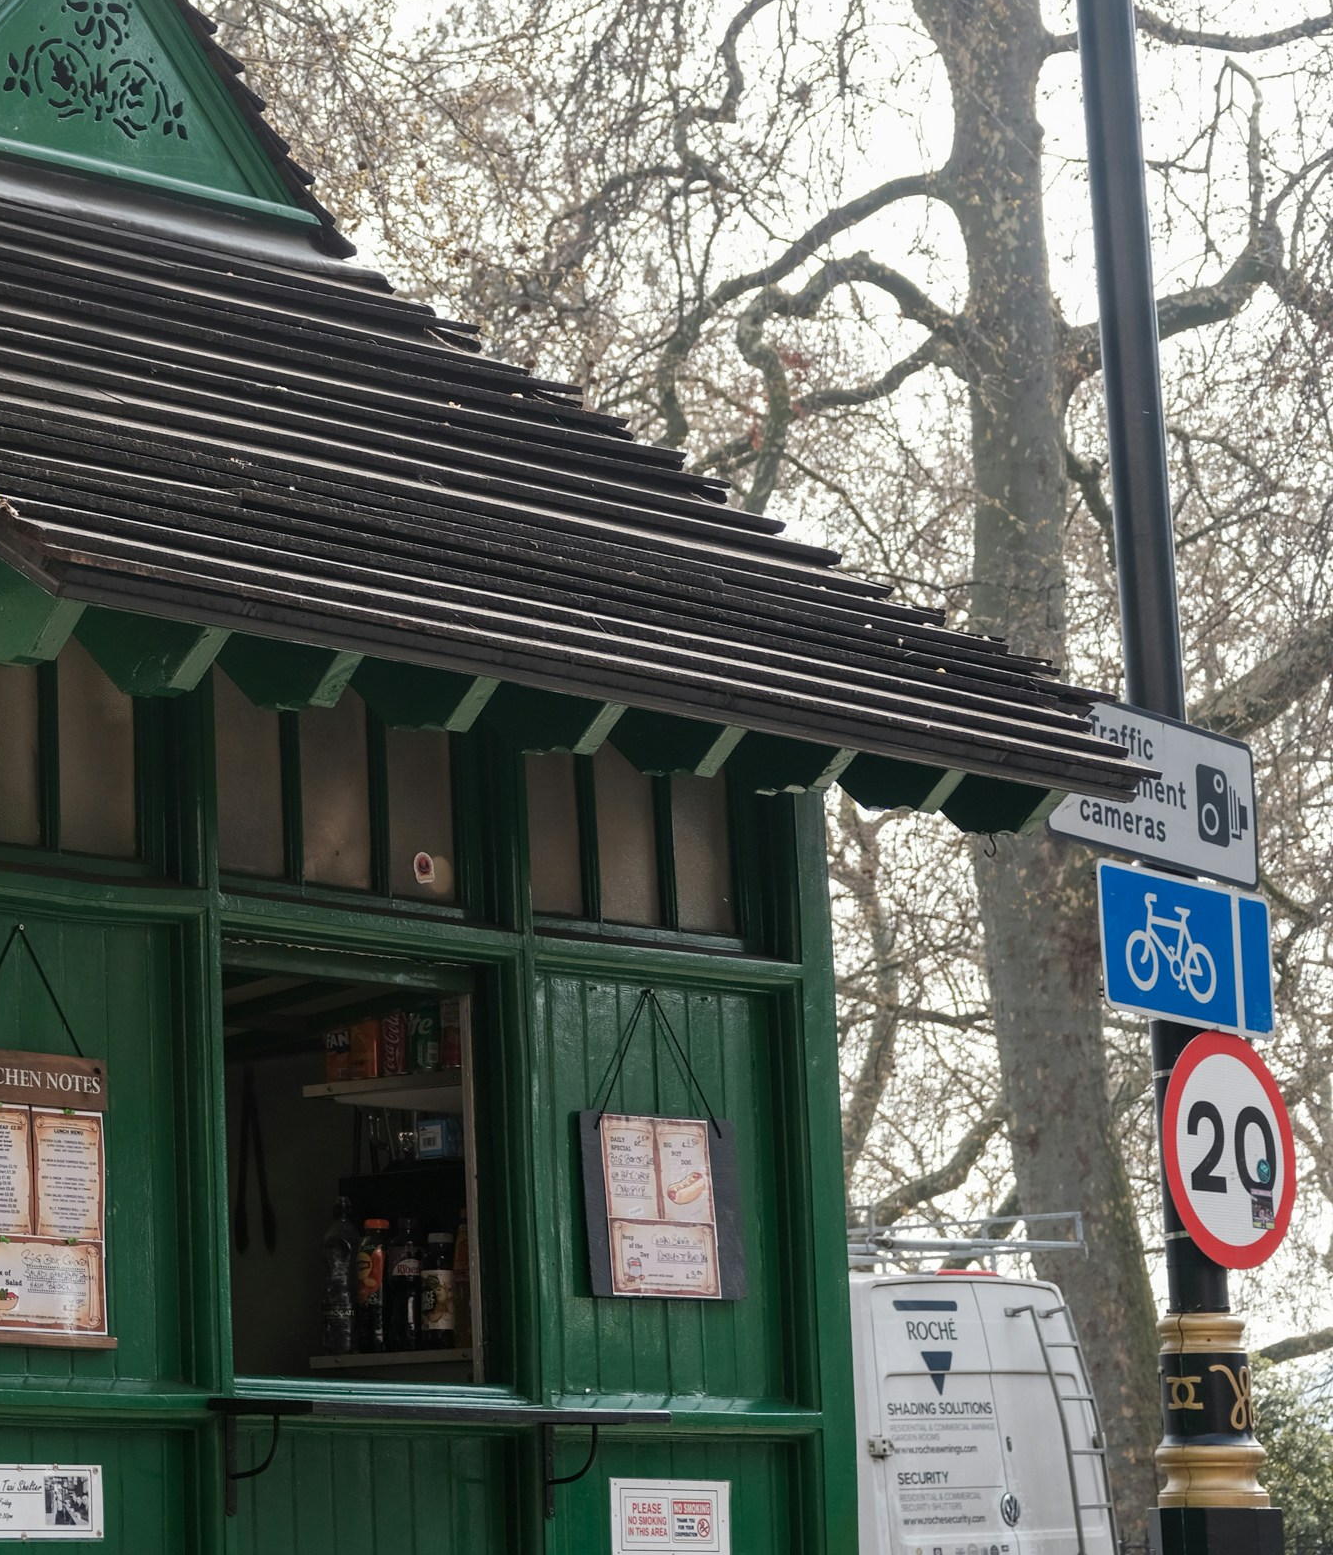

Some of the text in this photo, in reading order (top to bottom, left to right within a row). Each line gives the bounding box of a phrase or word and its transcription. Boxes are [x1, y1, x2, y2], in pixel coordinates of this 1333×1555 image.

[1088, 715, 1153, 760] Traffic
[1136, 777, 1187, 810] ment
[1080, 799, 1166, 842] cameras
[46, 1072, 101, 1094] NOTES
[1187, 1100, 1276, 1193] 20
[640, 1251, 649, 1259] Day
[906, 1318, 958, 1340] ROCHÉ
[887, 1402, 993, 1416] SHADING SOLUTIONS
[890, 1424, 927, 1432] RESIDENTIAL
[894, 1445, 978, 1455] www.rocheawnings.com
[897, 1471, 949, 1485] SECURITY
[2, 1480, 16, 1491] Taxi
[18, 1480, 42, 1492] Shelter
[899, 1493, 937, 1502] RESIDENTIAL
[632, 1502, 662, 1514] PLEASE
[673, 1503, 710, 1514] NO SMOKING
[901, 1502, 962, 1512] SECURITY SHUTTERS
[628, 1516, 667, 1525] NO SMOKING
[903, 1514, 986, 1525] www.rochesecurity.com
[628, 1527, 668, 1537] IN THIS AREA
